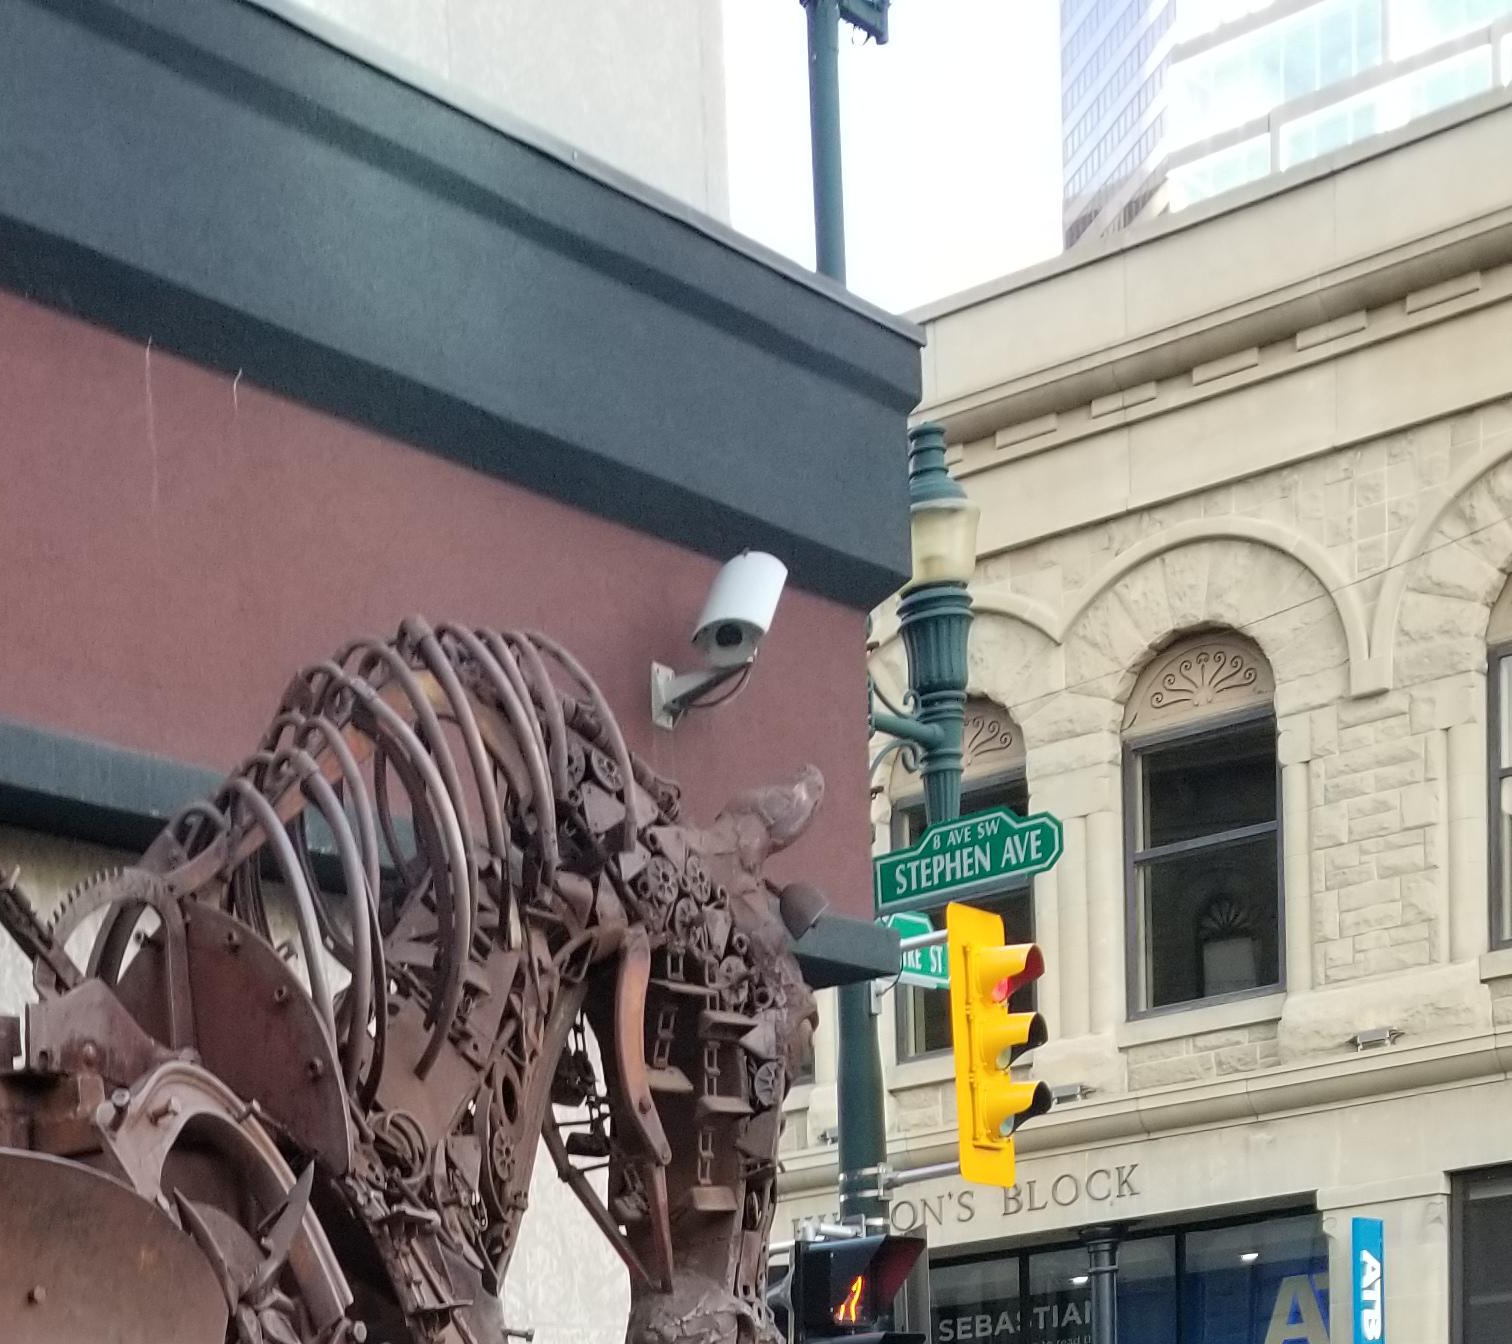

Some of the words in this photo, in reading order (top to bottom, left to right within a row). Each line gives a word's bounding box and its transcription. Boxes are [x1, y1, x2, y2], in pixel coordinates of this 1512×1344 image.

[933, 834, 941, 849] 8
[947, 826, 972, 847] AVE
[977, 818, 1001, 840] SW
[895, 843, 991, 895] STEPHEN
[1001, 828, 1043, 868] AVE
[930, 945, 943, 973] ST
[1002, 1164, 1140, 1217] BLOCK
[1360, 1249, 1382, 1341] ATB
